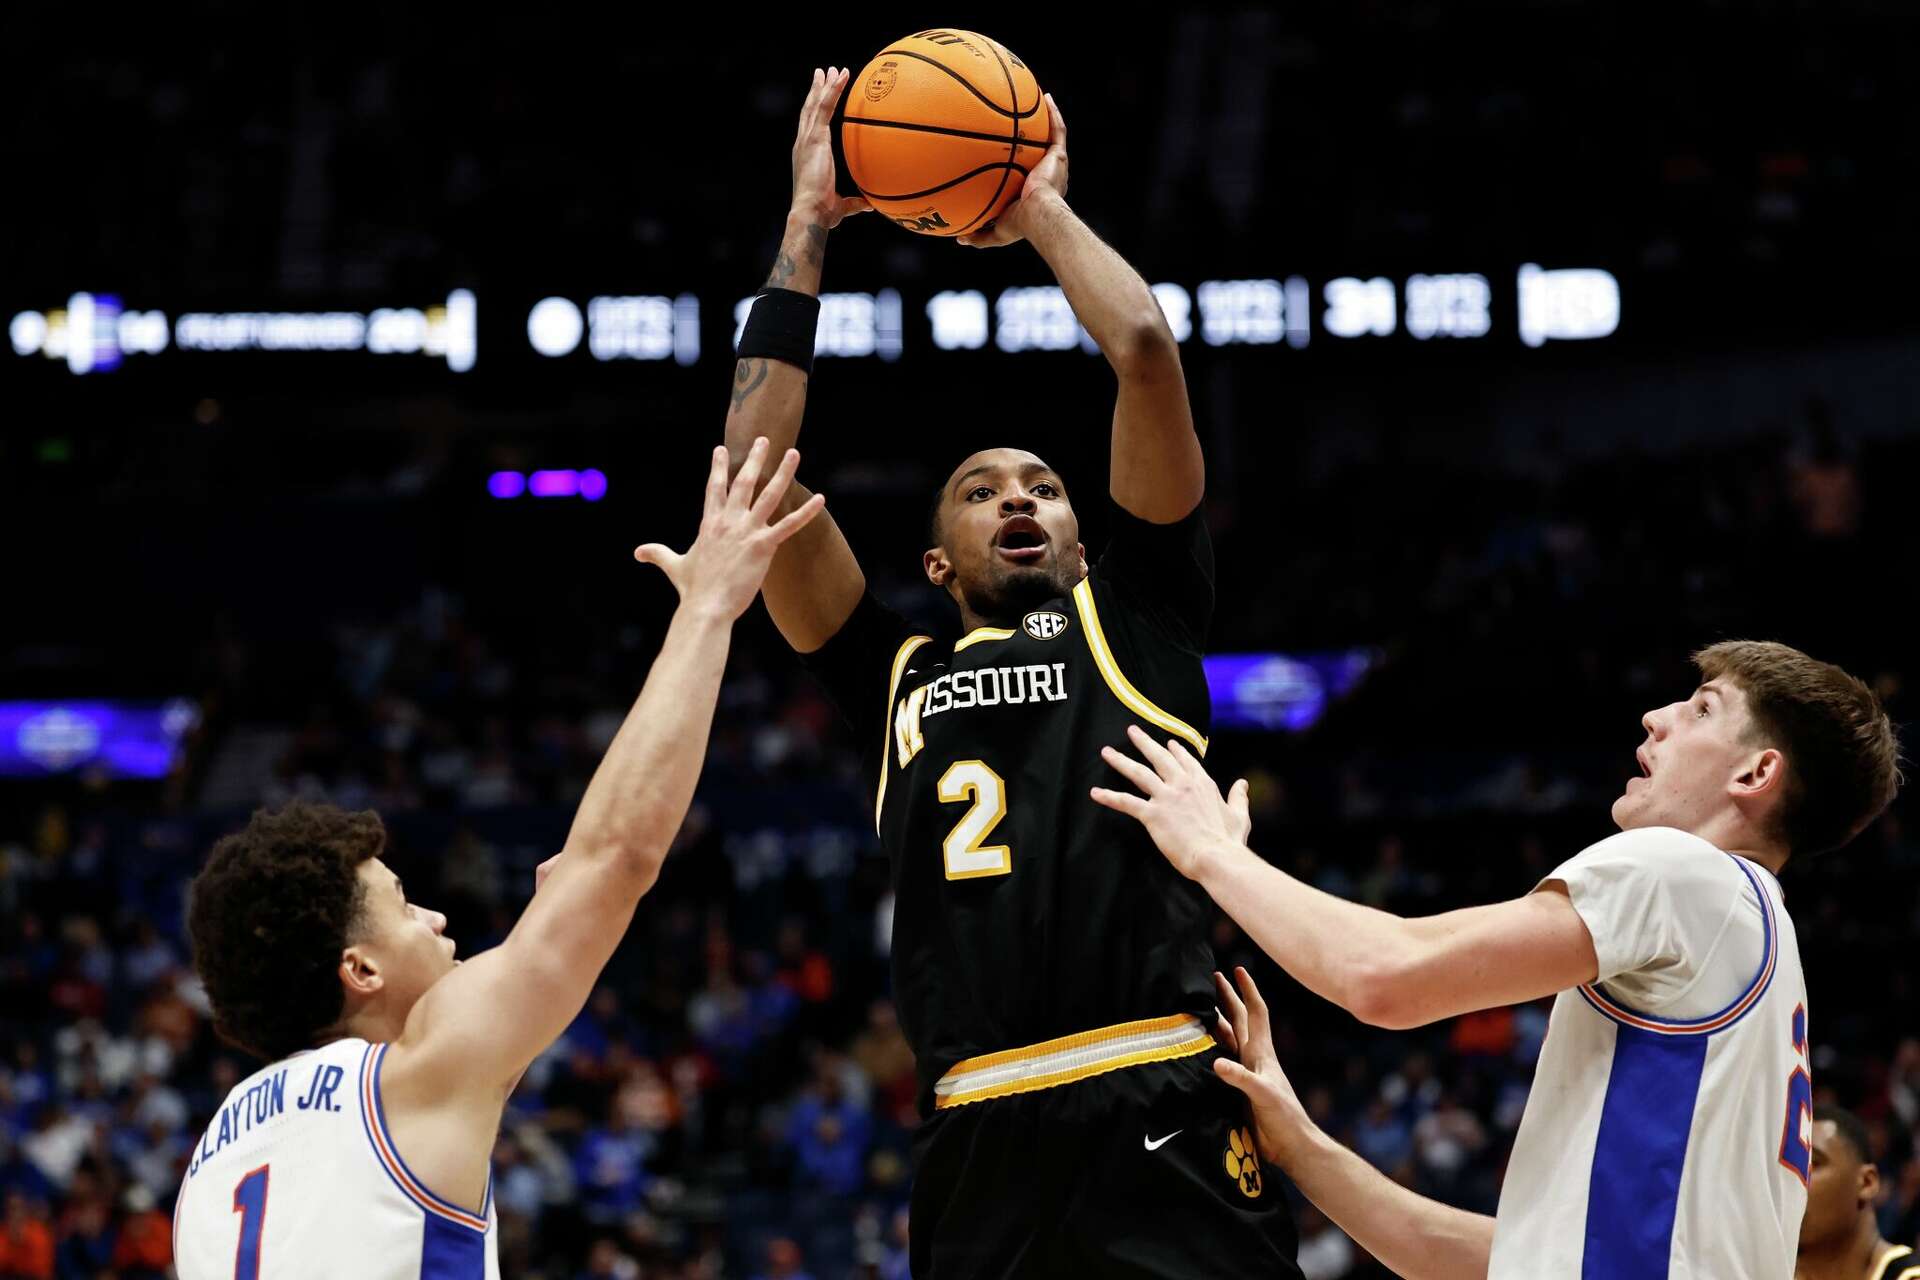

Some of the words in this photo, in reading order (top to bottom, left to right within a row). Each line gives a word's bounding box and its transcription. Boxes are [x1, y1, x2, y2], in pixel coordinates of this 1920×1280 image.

[1025, 613, 1064, 638] SEC
[894, 662, 1069, 771] MISSOURI
[936, 759, 1013, 881] 2
[297, 1064, 345, 1112] JR.
[1242, 1170, 1261, 1194] M
[232, 1163, 270, 1280] 1
